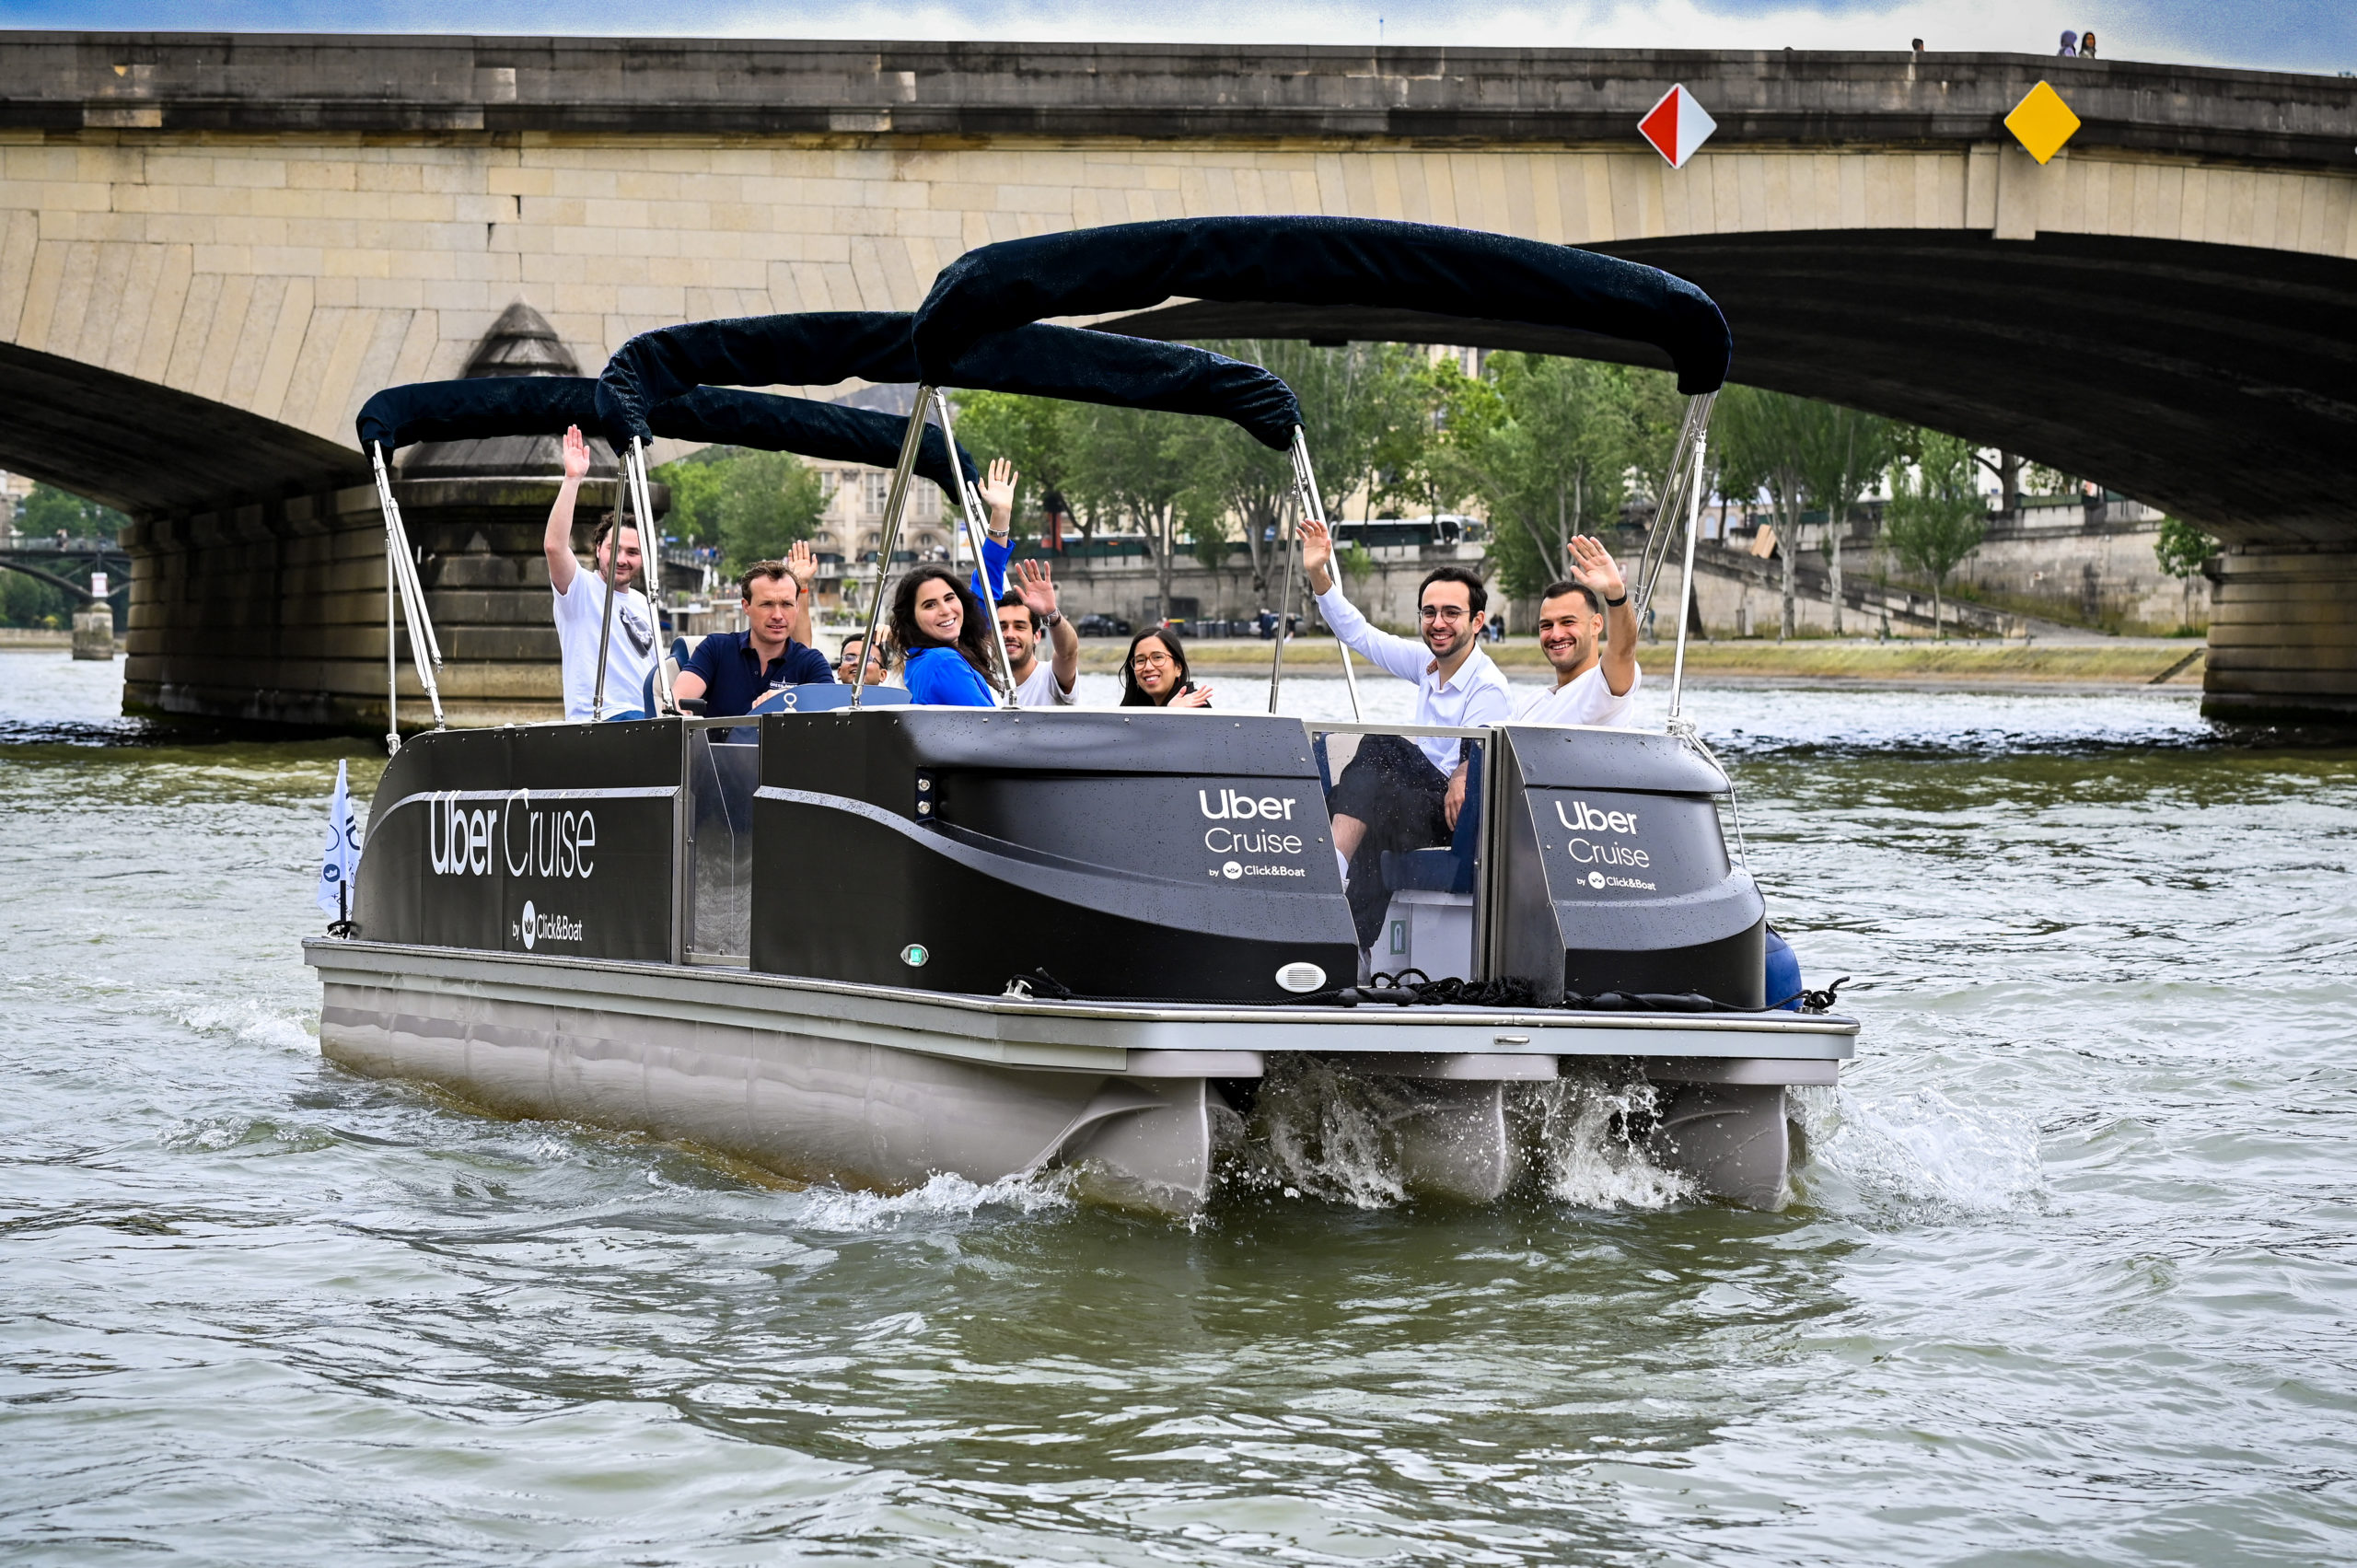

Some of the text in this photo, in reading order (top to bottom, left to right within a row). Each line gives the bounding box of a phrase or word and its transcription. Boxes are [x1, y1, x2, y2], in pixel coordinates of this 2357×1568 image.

[1199, 789, 1295, 819] Uber
[1555, 801, 1637, 834] Uber
[430, 790, 497, 876] Uber
[504, 788, 596, 878] Cruise
[1204, 827, 1302, 854] Cruise
[1568, 838, 1650, 868] Cruise
[1244, 865, 1306, 877] Click&Boat
[1576, 876, 1656, 890] by Click&Boat
[512, 913, 583, 942] by Click&Boat
